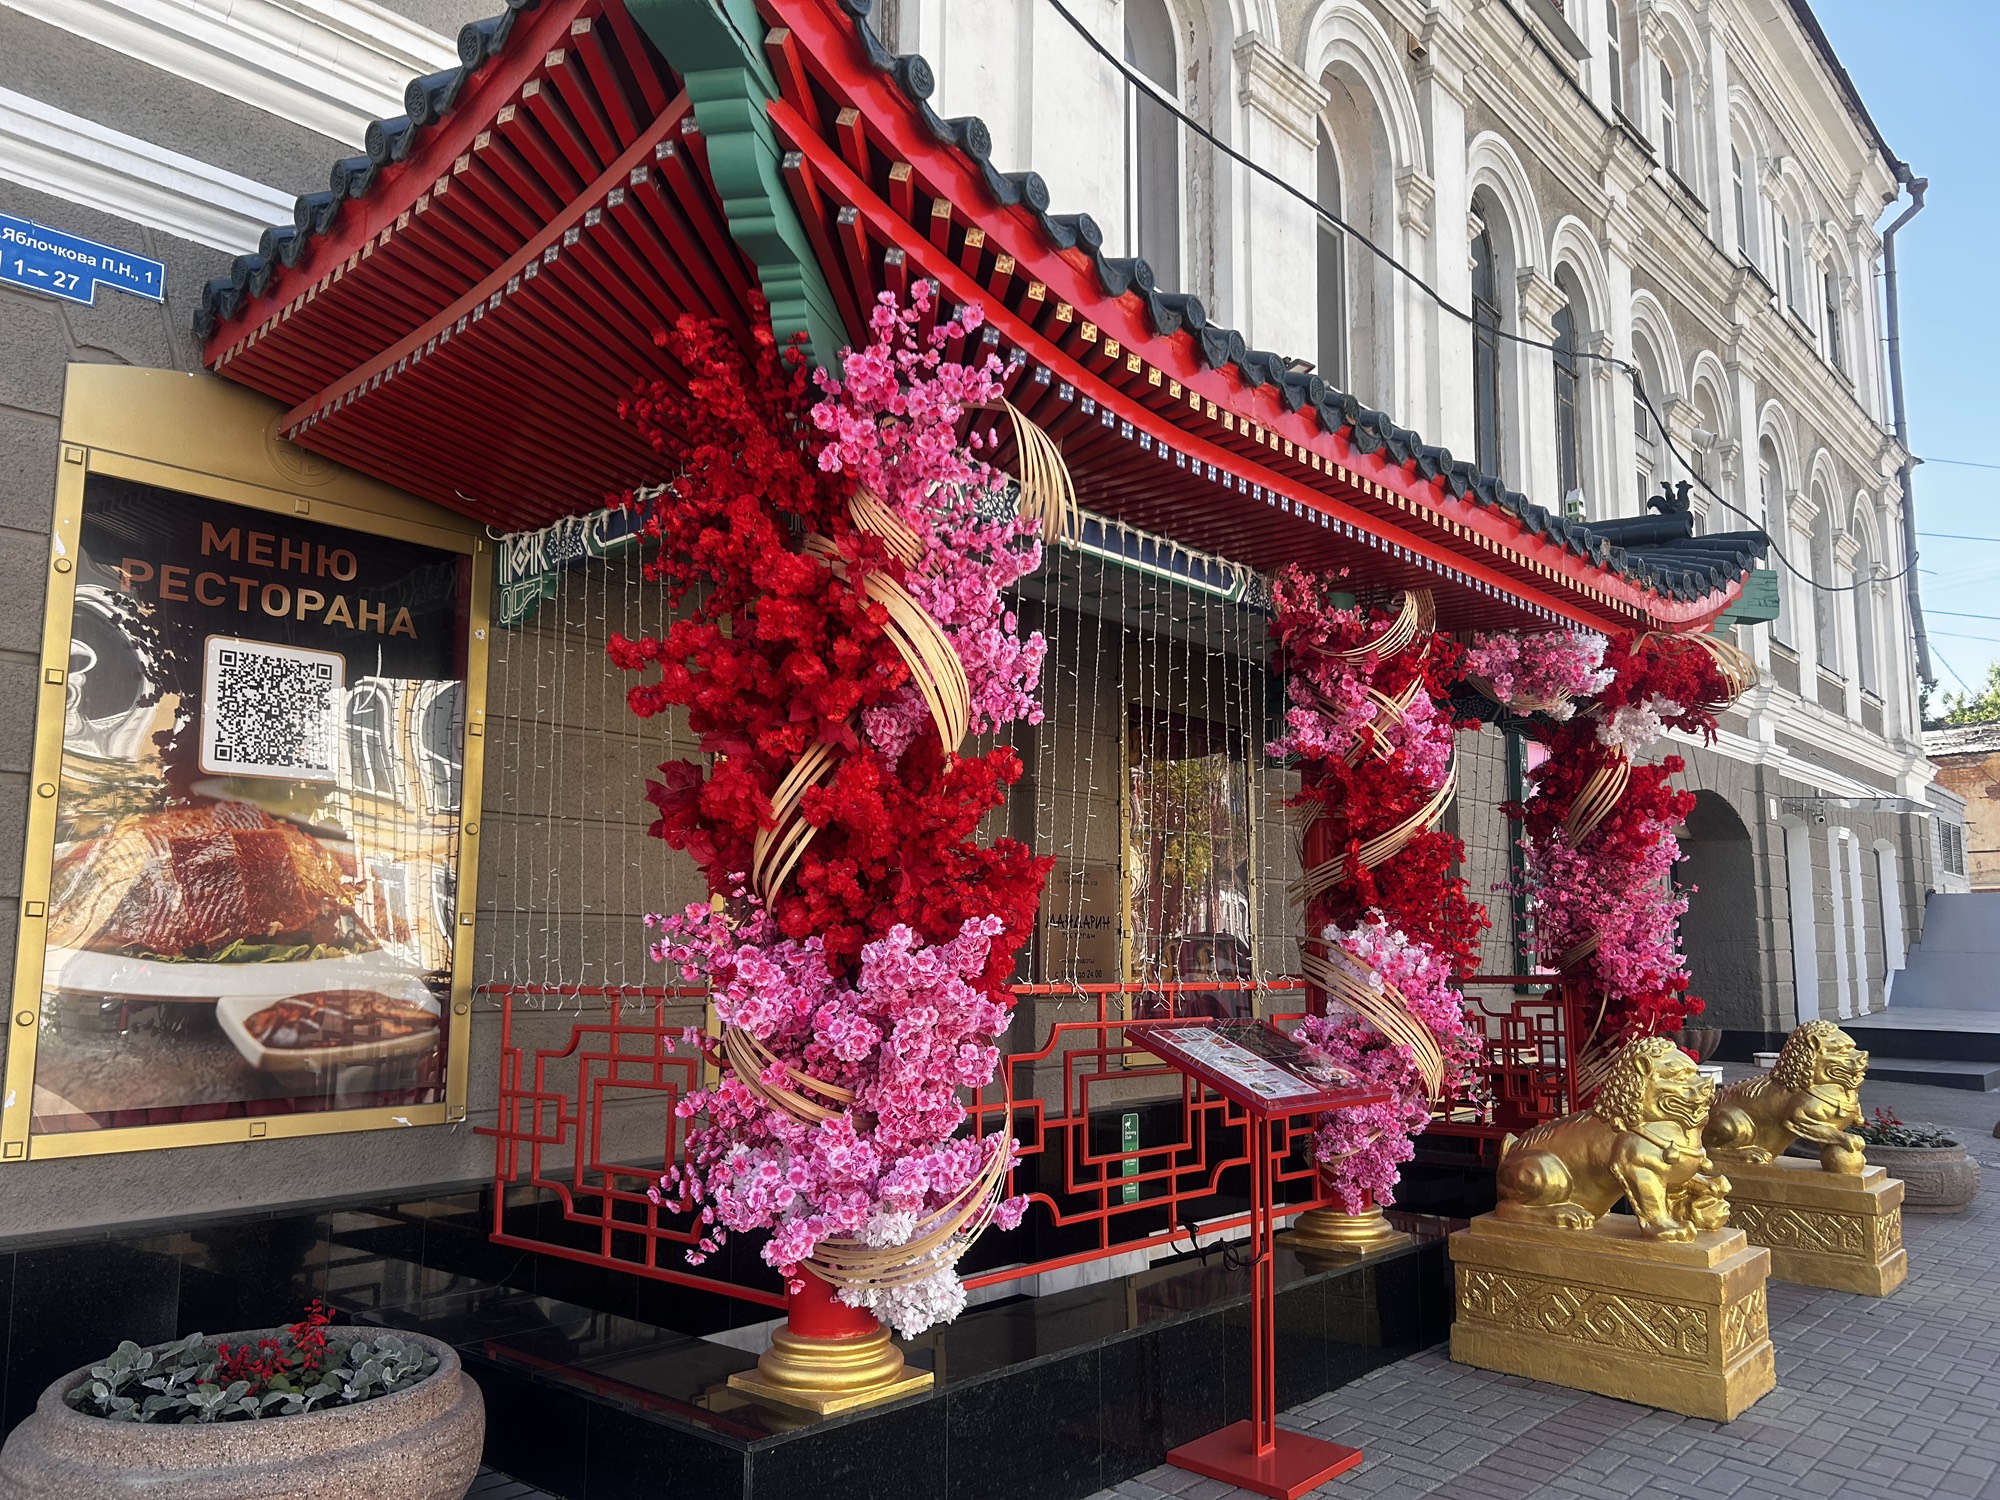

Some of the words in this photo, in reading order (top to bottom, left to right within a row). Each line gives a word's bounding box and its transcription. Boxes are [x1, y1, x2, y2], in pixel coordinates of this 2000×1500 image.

[14, 259, 24, 276] 1
[53, 271, 80, 291] 27
[145, 271, 152, 283] 1
[200, 521, 358, 582] МЕНЮ
[119, 557, 418, 640] РЕСТОРАНА
